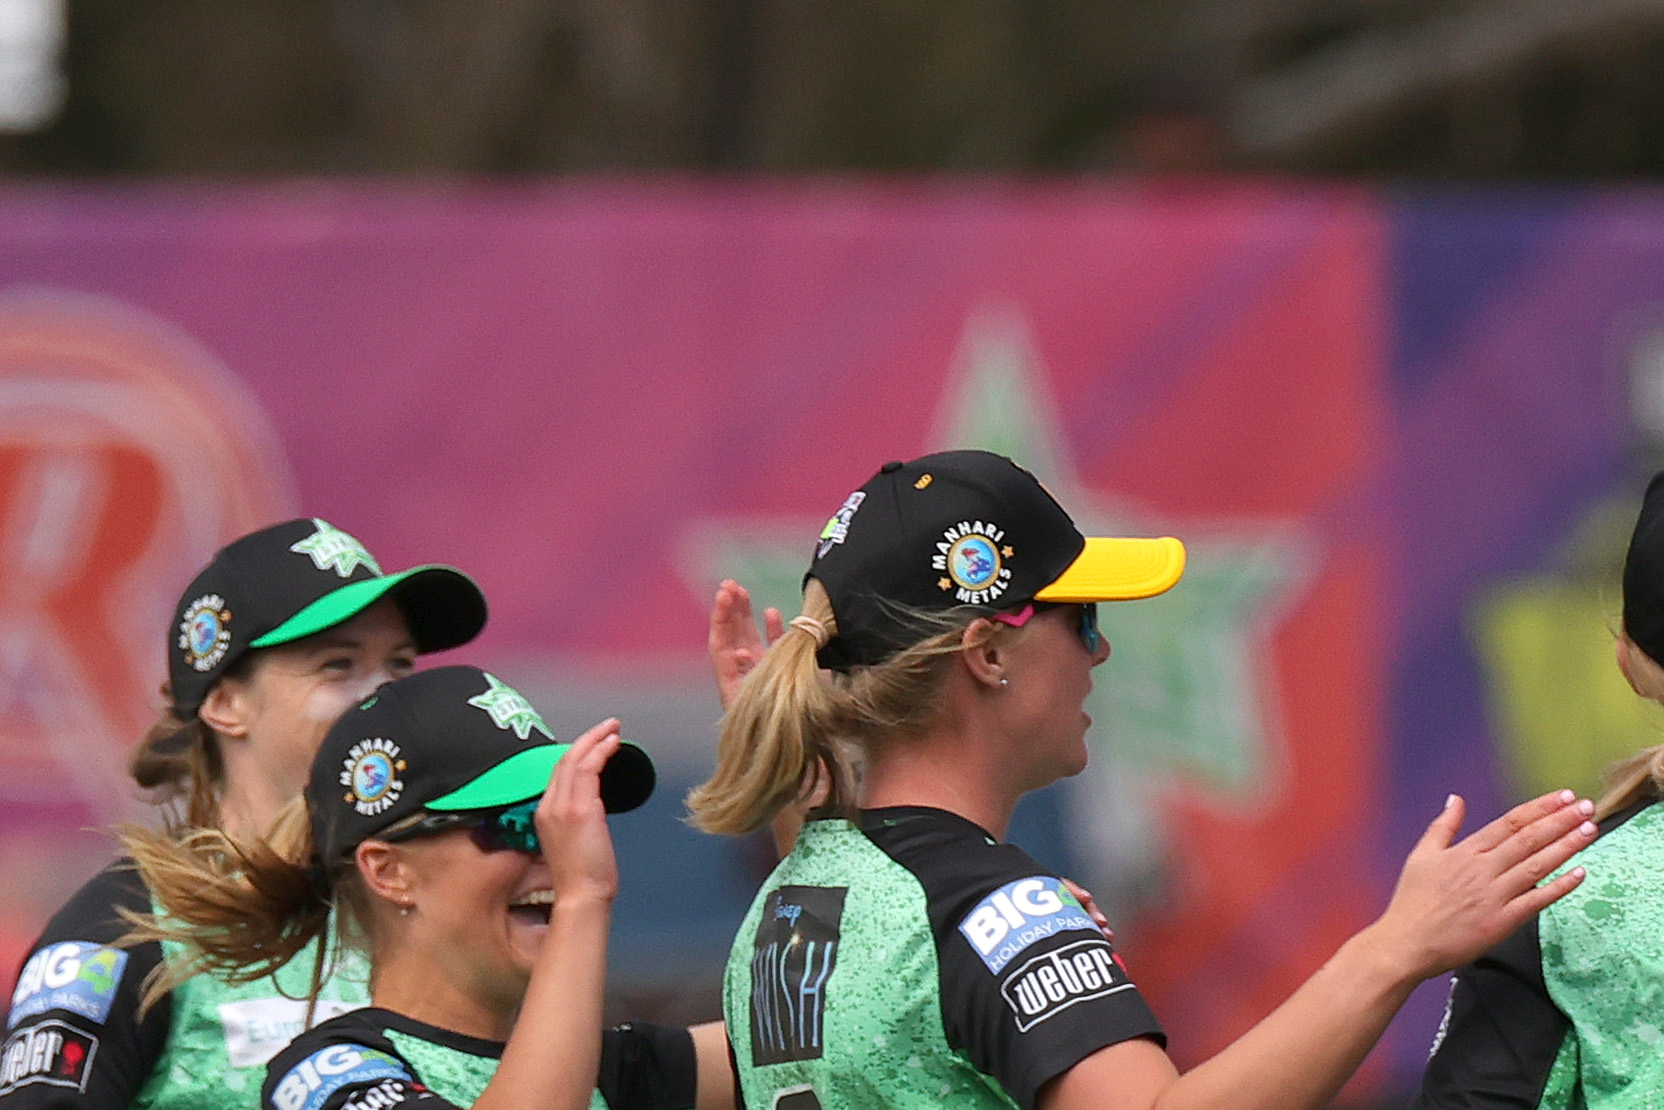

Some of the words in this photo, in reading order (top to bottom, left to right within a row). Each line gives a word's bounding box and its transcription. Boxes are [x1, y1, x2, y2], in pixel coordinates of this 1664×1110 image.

[931, 520, 1005, 570] MANHARI
[955, 567, 1012, 604] METALS
[340, 737, 401, 787] MANHARI
[989, 921, 1054, 971] HOLIDAY
[1013, 947, 1114, 1016] weber
